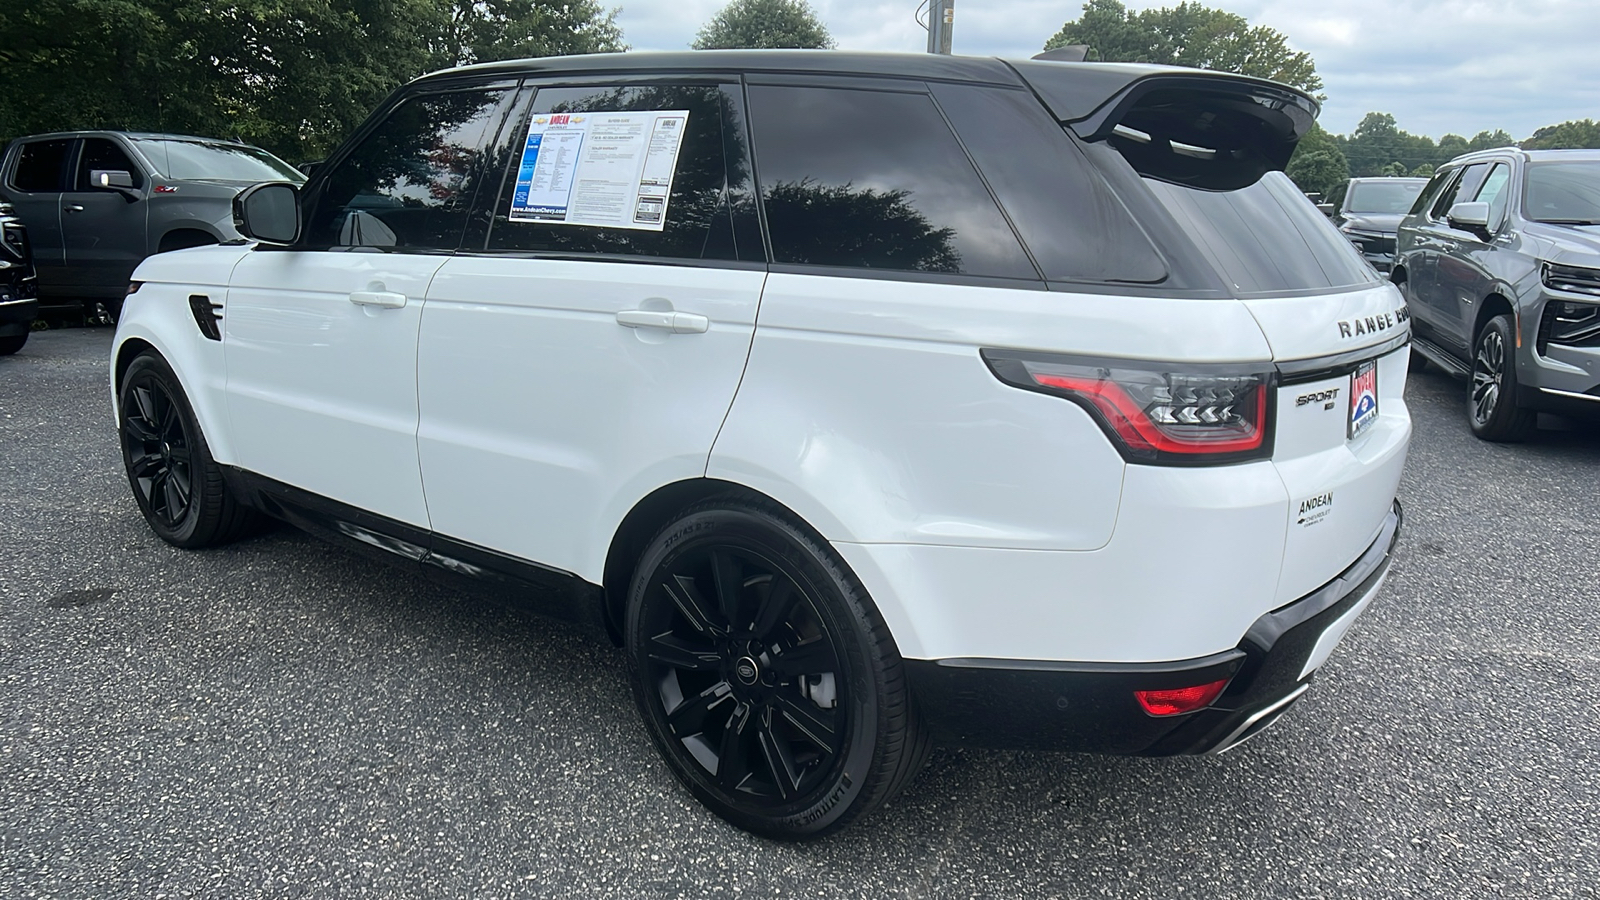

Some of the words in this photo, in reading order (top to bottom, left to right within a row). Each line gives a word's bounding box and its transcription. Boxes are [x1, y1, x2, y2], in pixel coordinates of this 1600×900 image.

[549, 115, 571, 126] ANDEAN
[1338, 312, 1394, 339] RANGE
[1295, 388, 1340, 407] SPORT
[1298, 491, 1334, 517] ANDEAN
[663, 524, 694, 549] 275/45
